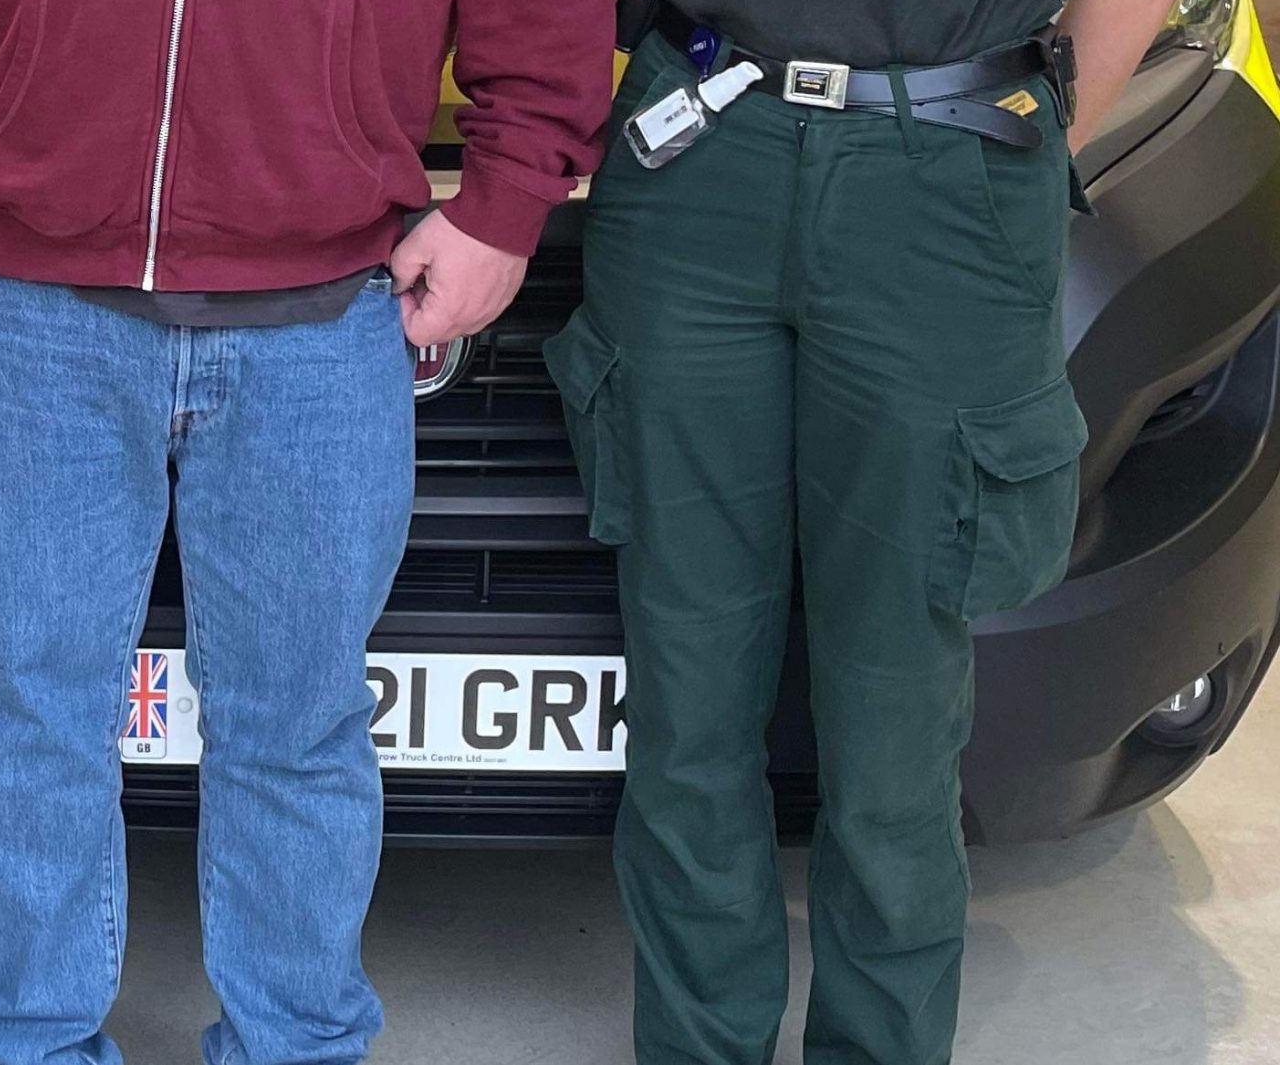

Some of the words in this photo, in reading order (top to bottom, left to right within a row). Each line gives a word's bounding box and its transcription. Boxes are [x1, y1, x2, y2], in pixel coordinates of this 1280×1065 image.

[136, 742, 151, 753] GB
[401, 752, 428, 762] Truck
[430, 753, 463, 763] Centre
[465, 754, 482, 763] Ltd
